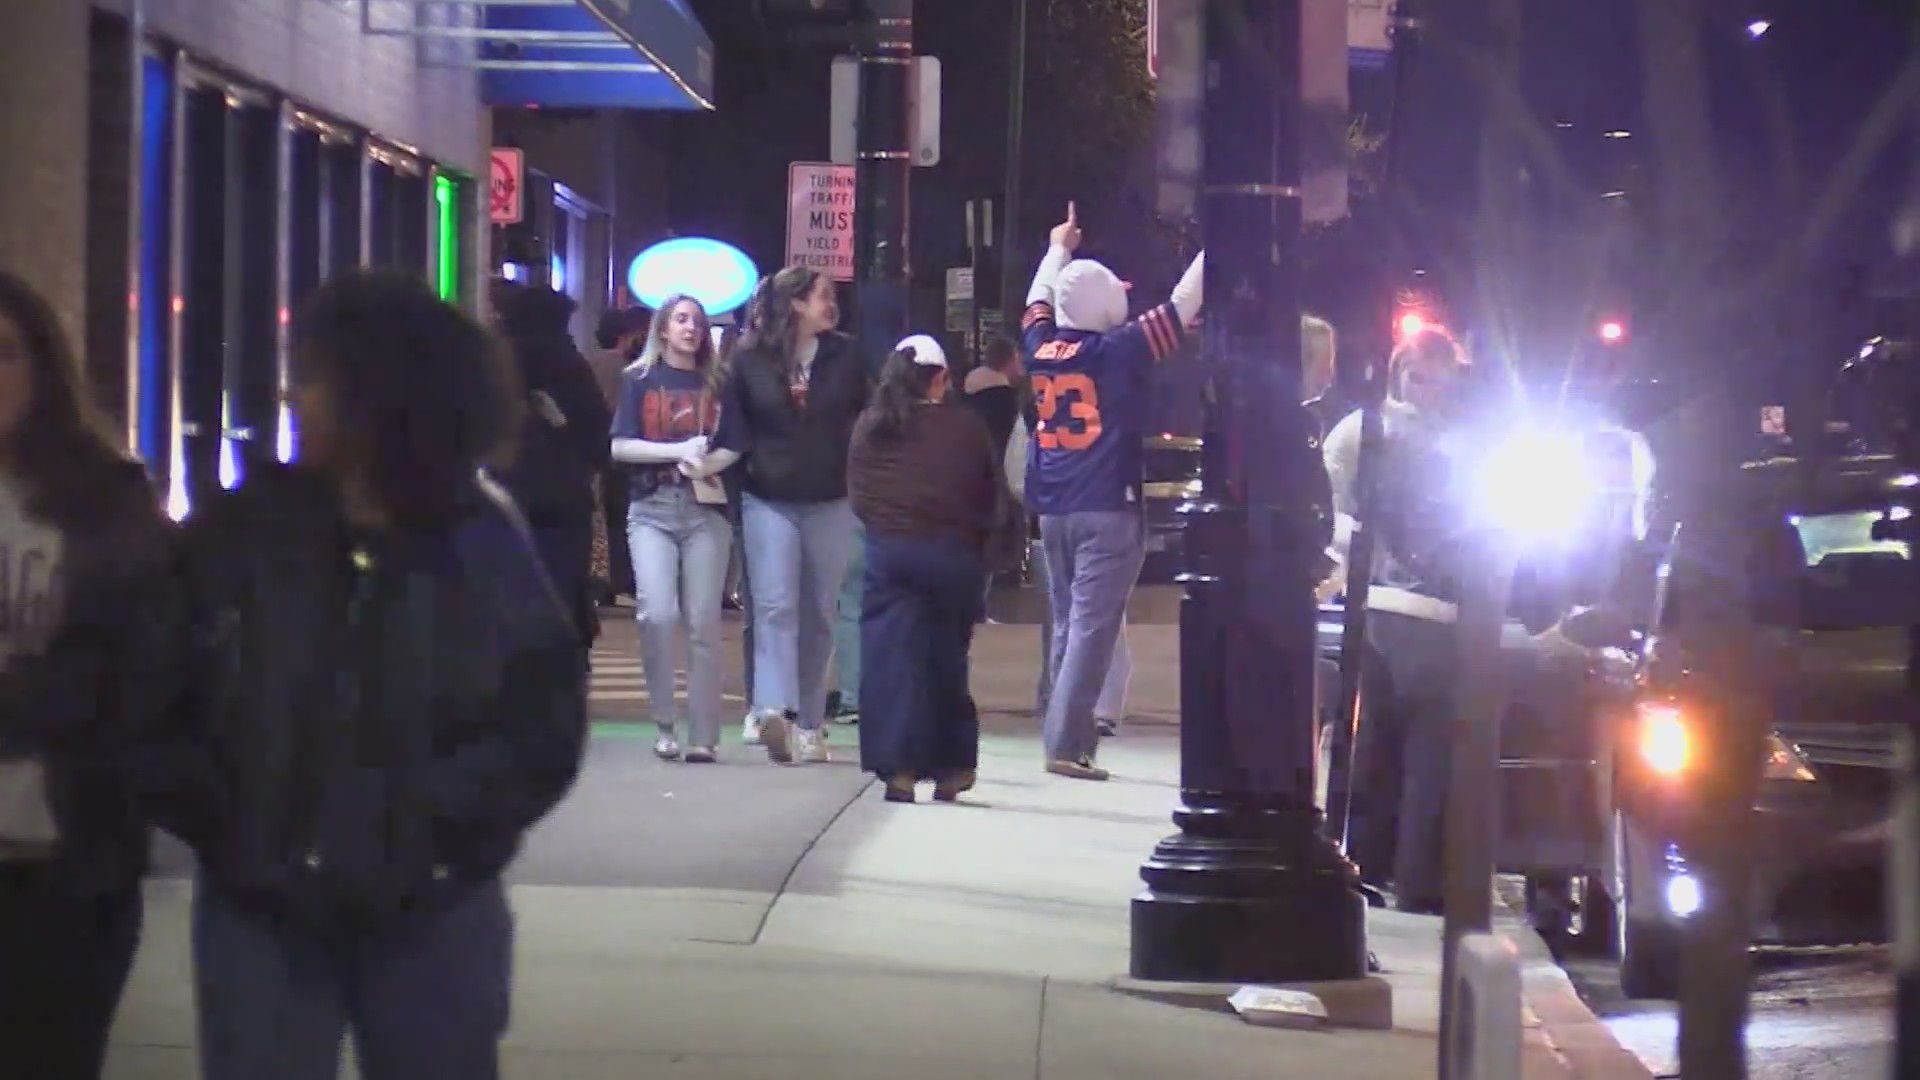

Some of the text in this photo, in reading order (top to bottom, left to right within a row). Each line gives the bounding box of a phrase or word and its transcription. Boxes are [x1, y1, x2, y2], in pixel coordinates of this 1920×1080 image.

[811, 174, 854, 189] TURNIN
[810, 191, 854, 206] TRAFFI
[806, 237, 840, 250] YIELD
[792, 253, 854, 268] PEDESTRI
[1031, 373, 1102, 450] 23
